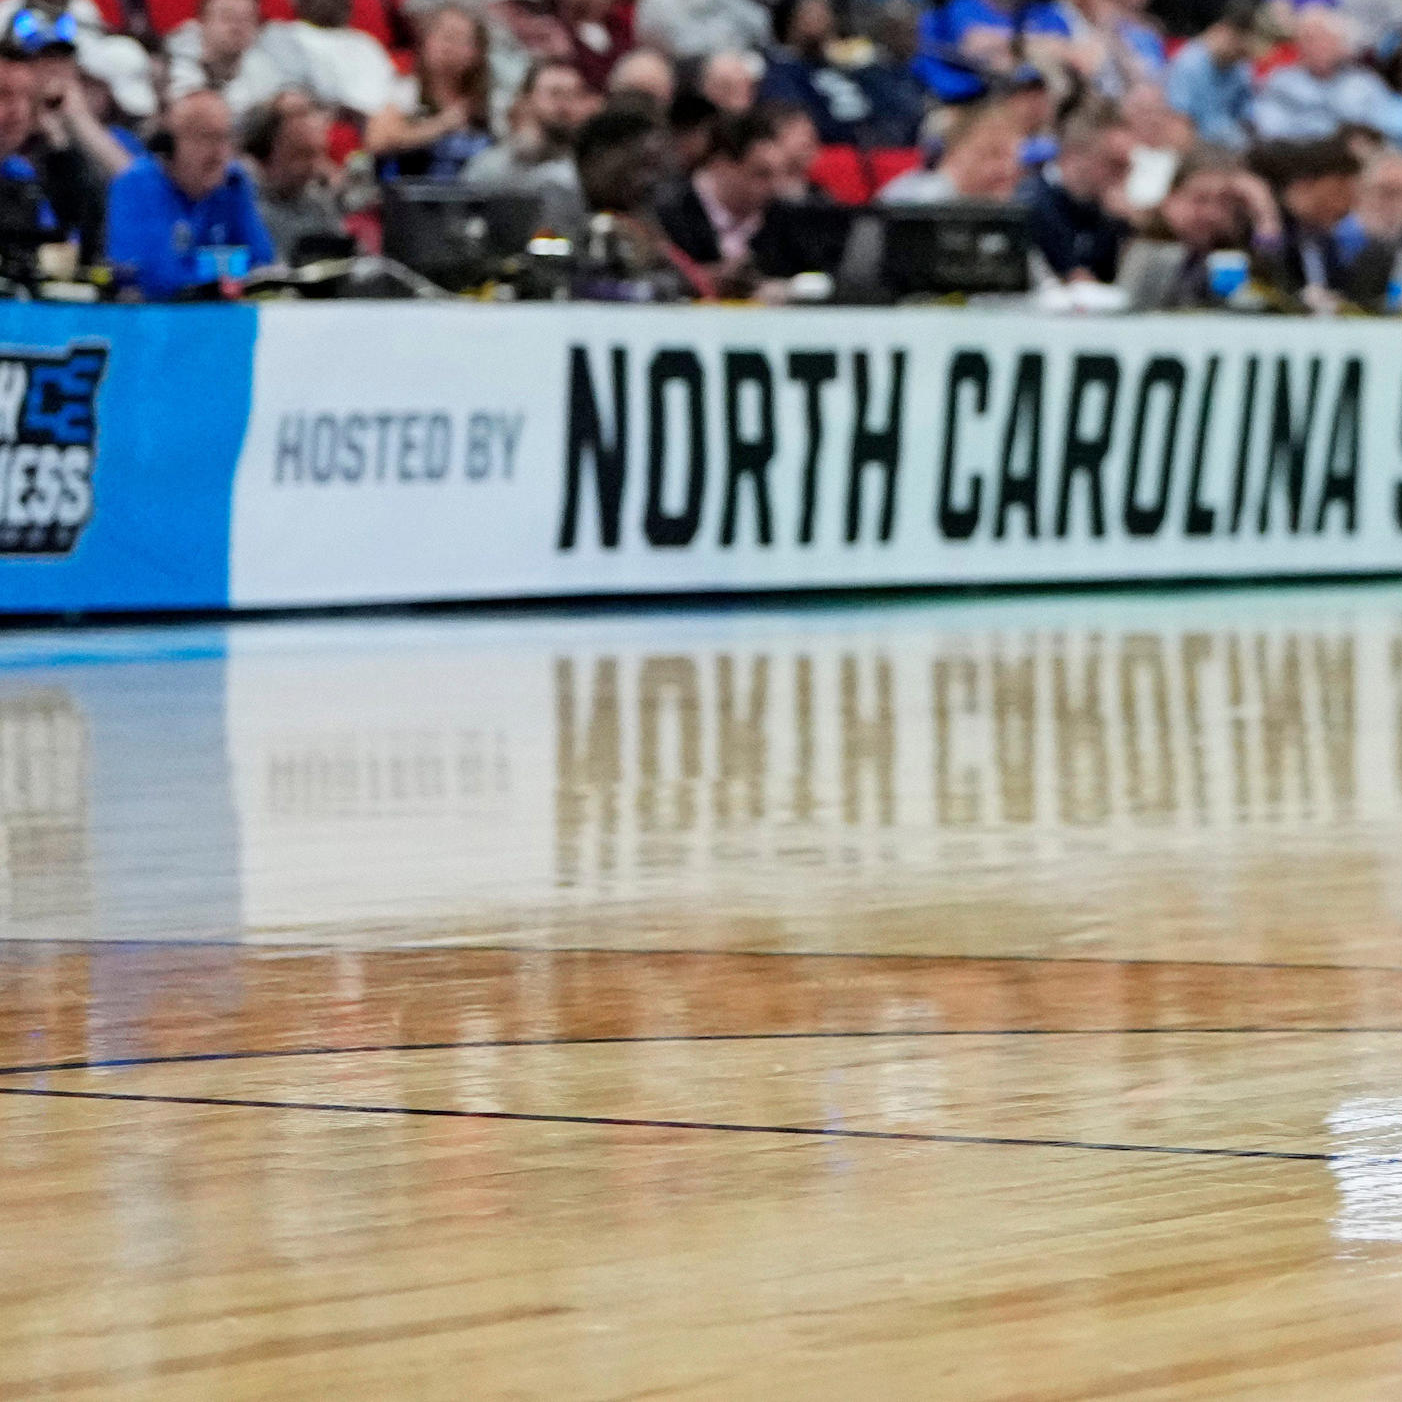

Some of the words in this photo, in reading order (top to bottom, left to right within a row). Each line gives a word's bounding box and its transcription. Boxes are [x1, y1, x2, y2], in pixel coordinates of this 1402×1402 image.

[273, 412, 452, 484] HOSTED
[463, 410, 525, 483] BY
[558, 346, 908, 550] NORTH
[937, 351, 1363, 539] CAROLINA
